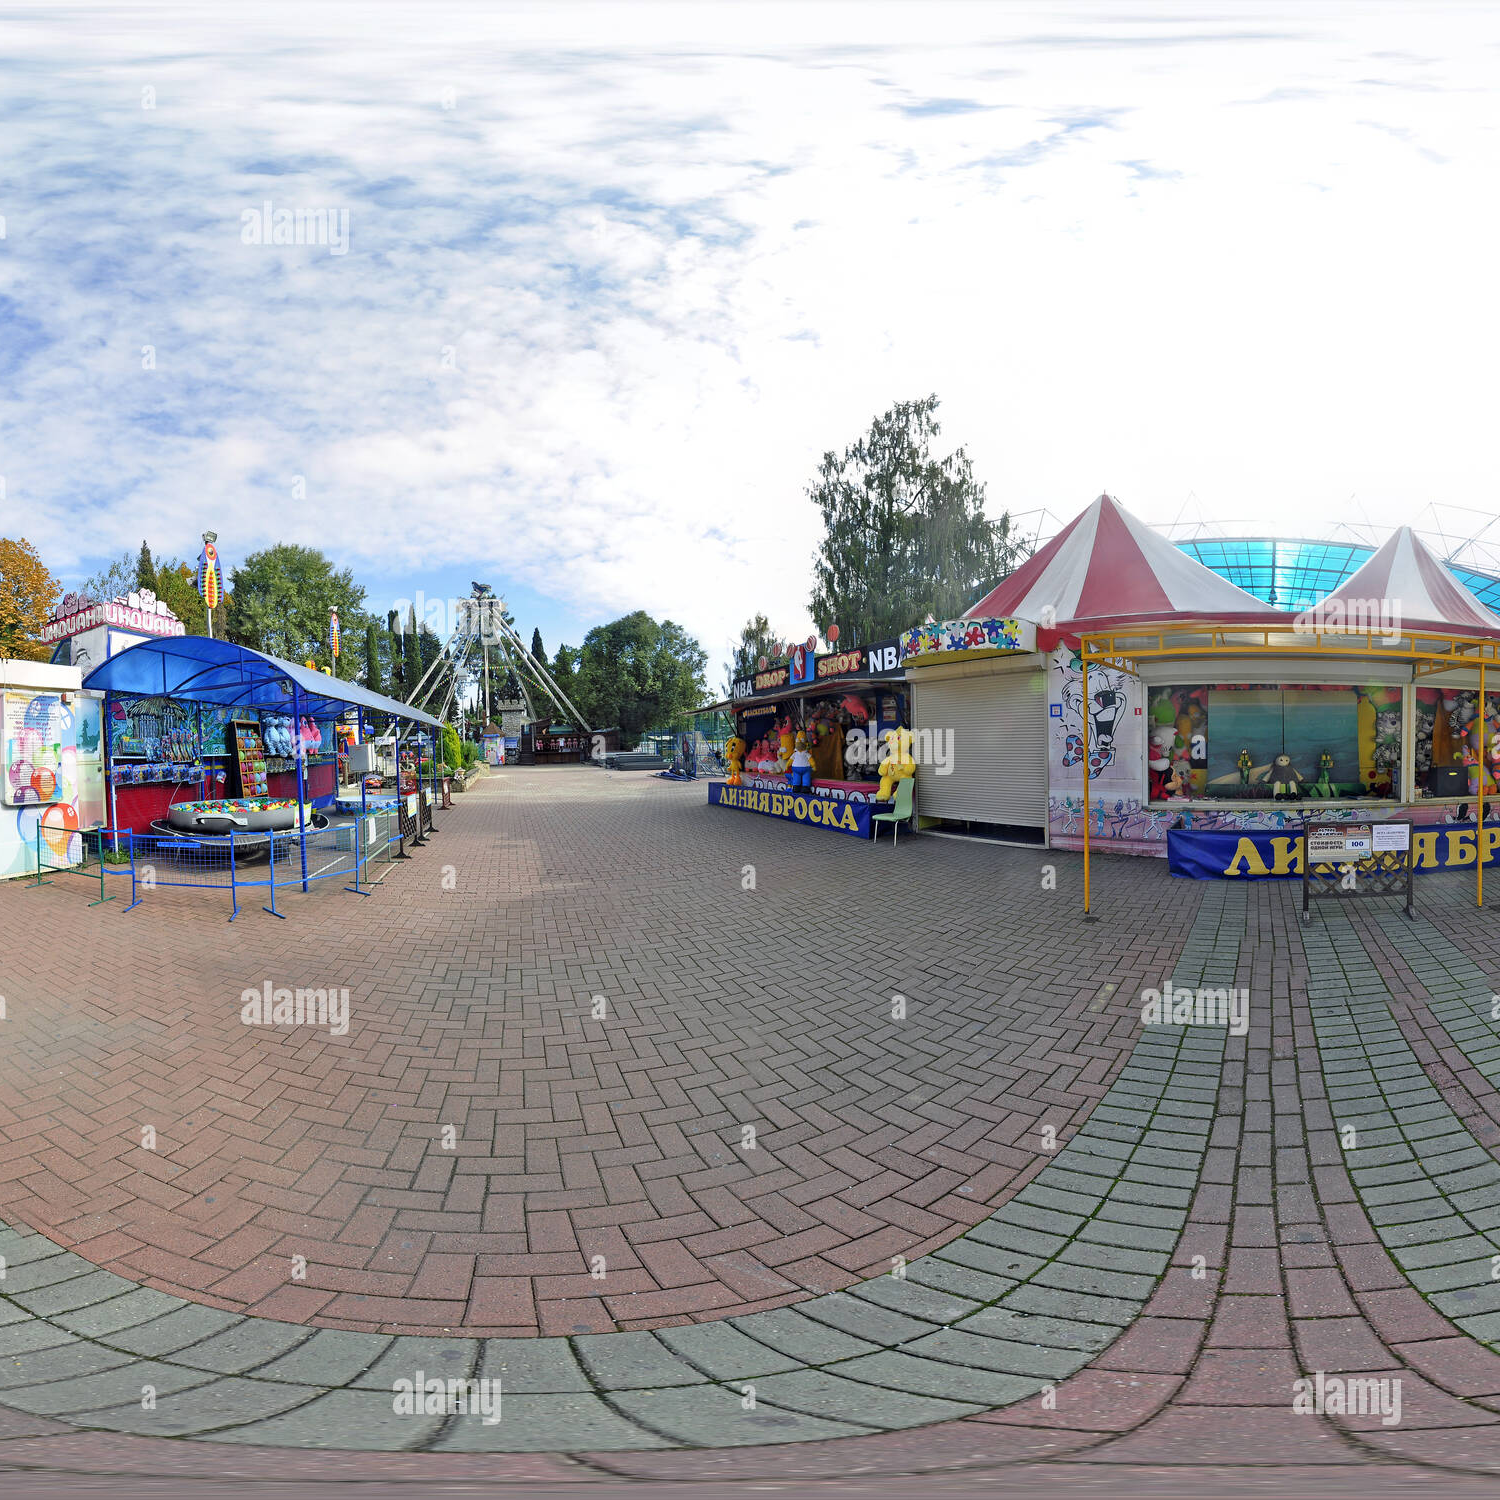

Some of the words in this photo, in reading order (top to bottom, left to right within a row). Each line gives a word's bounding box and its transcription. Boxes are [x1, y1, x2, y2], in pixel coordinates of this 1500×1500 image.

[733, 679, 753, 699] NBA
[755, 668, 786, 690] DROP
[817, 650, 862, 677] SHOT
[869, 646, 903, 674] NB
[719, 786, 770, 813] ЛИНИЯ
[771, 794, 859, 832] БРОСКА
[1223, 831, 1439, 876] ЛИЯ
